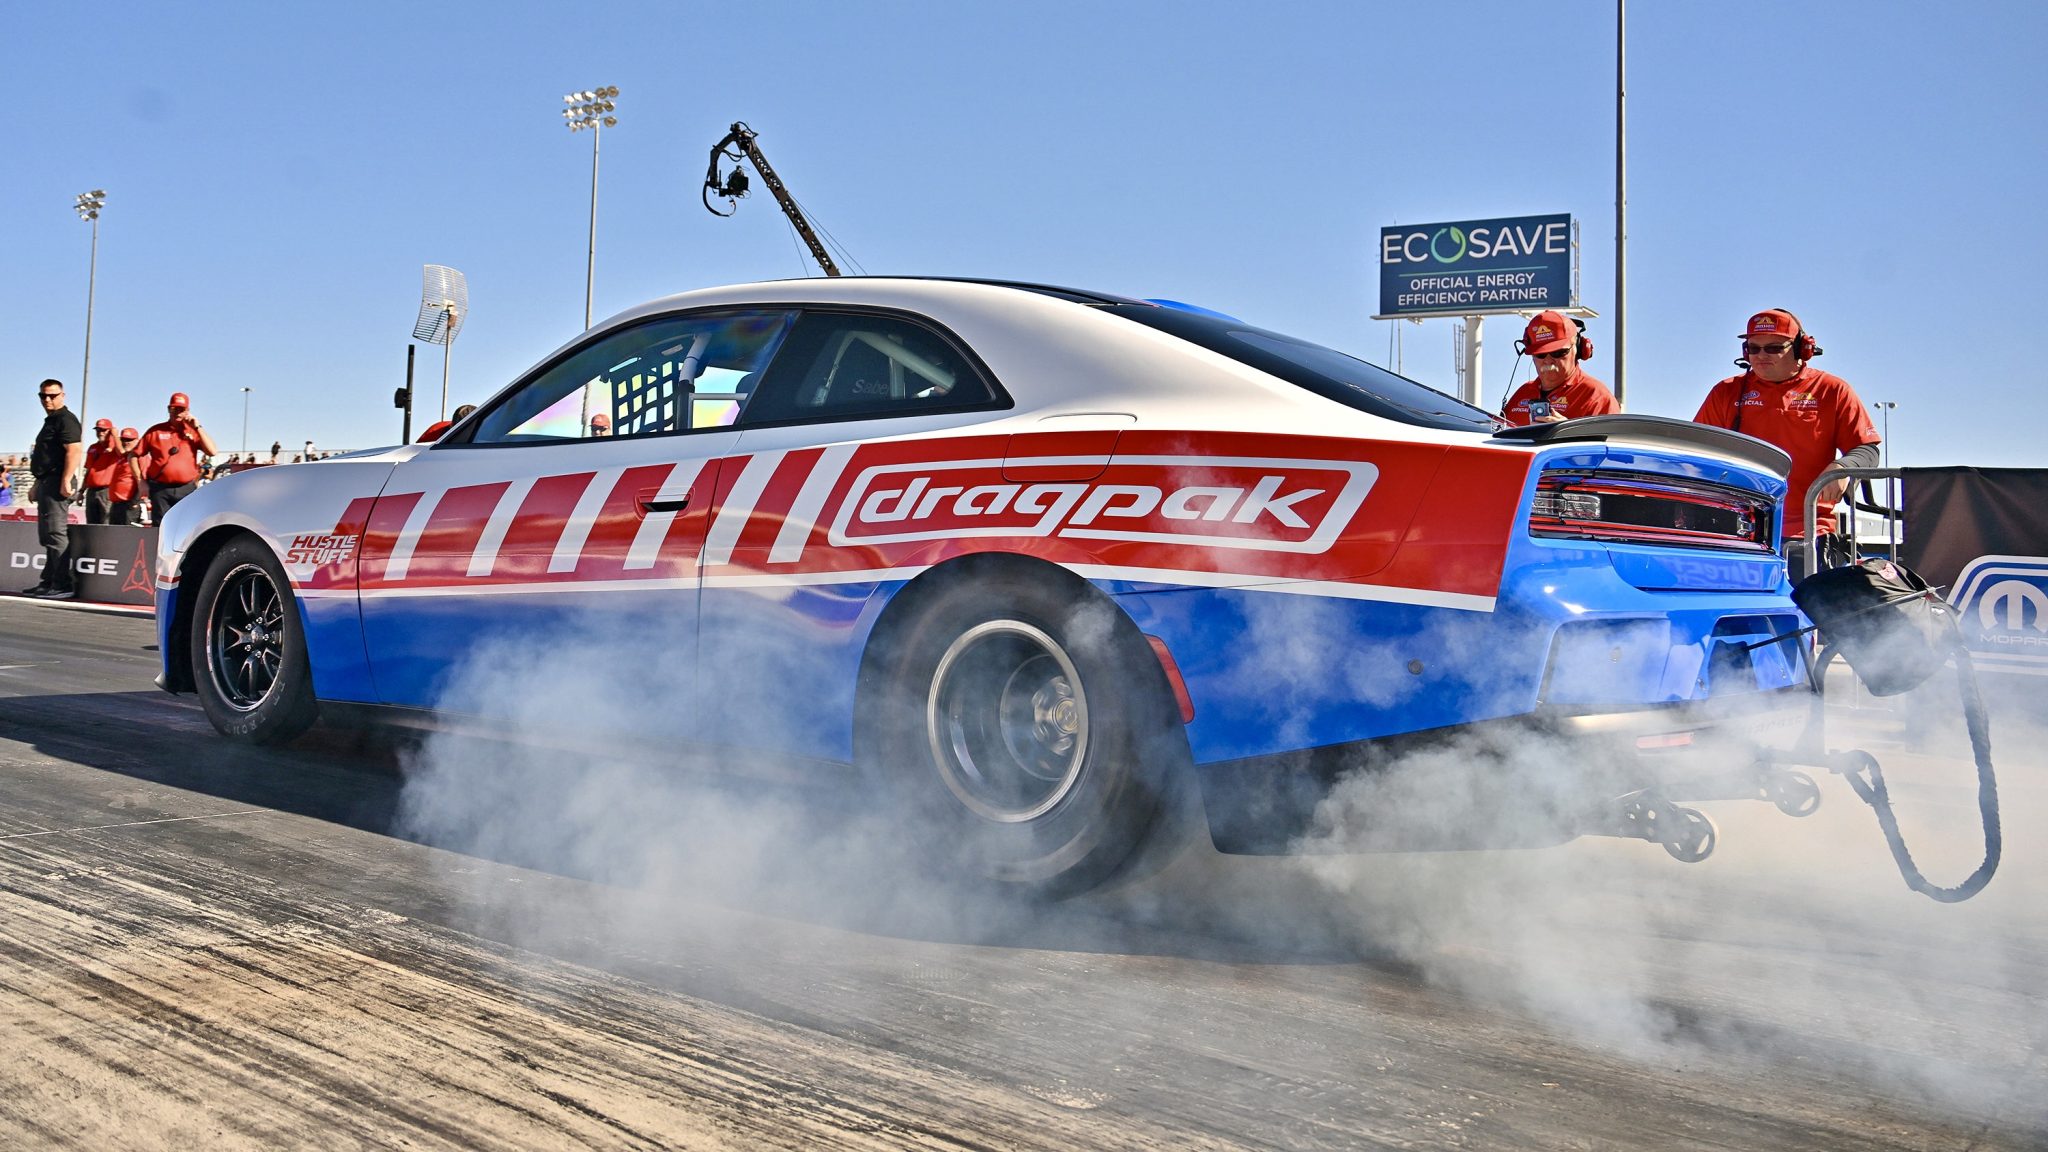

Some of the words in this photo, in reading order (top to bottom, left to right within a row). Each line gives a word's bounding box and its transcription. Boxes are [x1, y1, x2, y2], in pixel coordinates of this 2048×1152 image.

[1383, 223, 1567, 263] ECOSAVE
[1410, 276, 1472, 291] OFFICIAL
[1477, 272, 1535, 287] ENERGY
[1398, 290, 1476, 305] EFFICIENCY
[1480, 287, 1548, 301] PARTNER
[859, 476, 1326, 532] dragpak
[291, 534, 359, 549] HUSTLE
[10, 552, 119, 576] DOGE
[285, 548, 353, 565] STUFF
